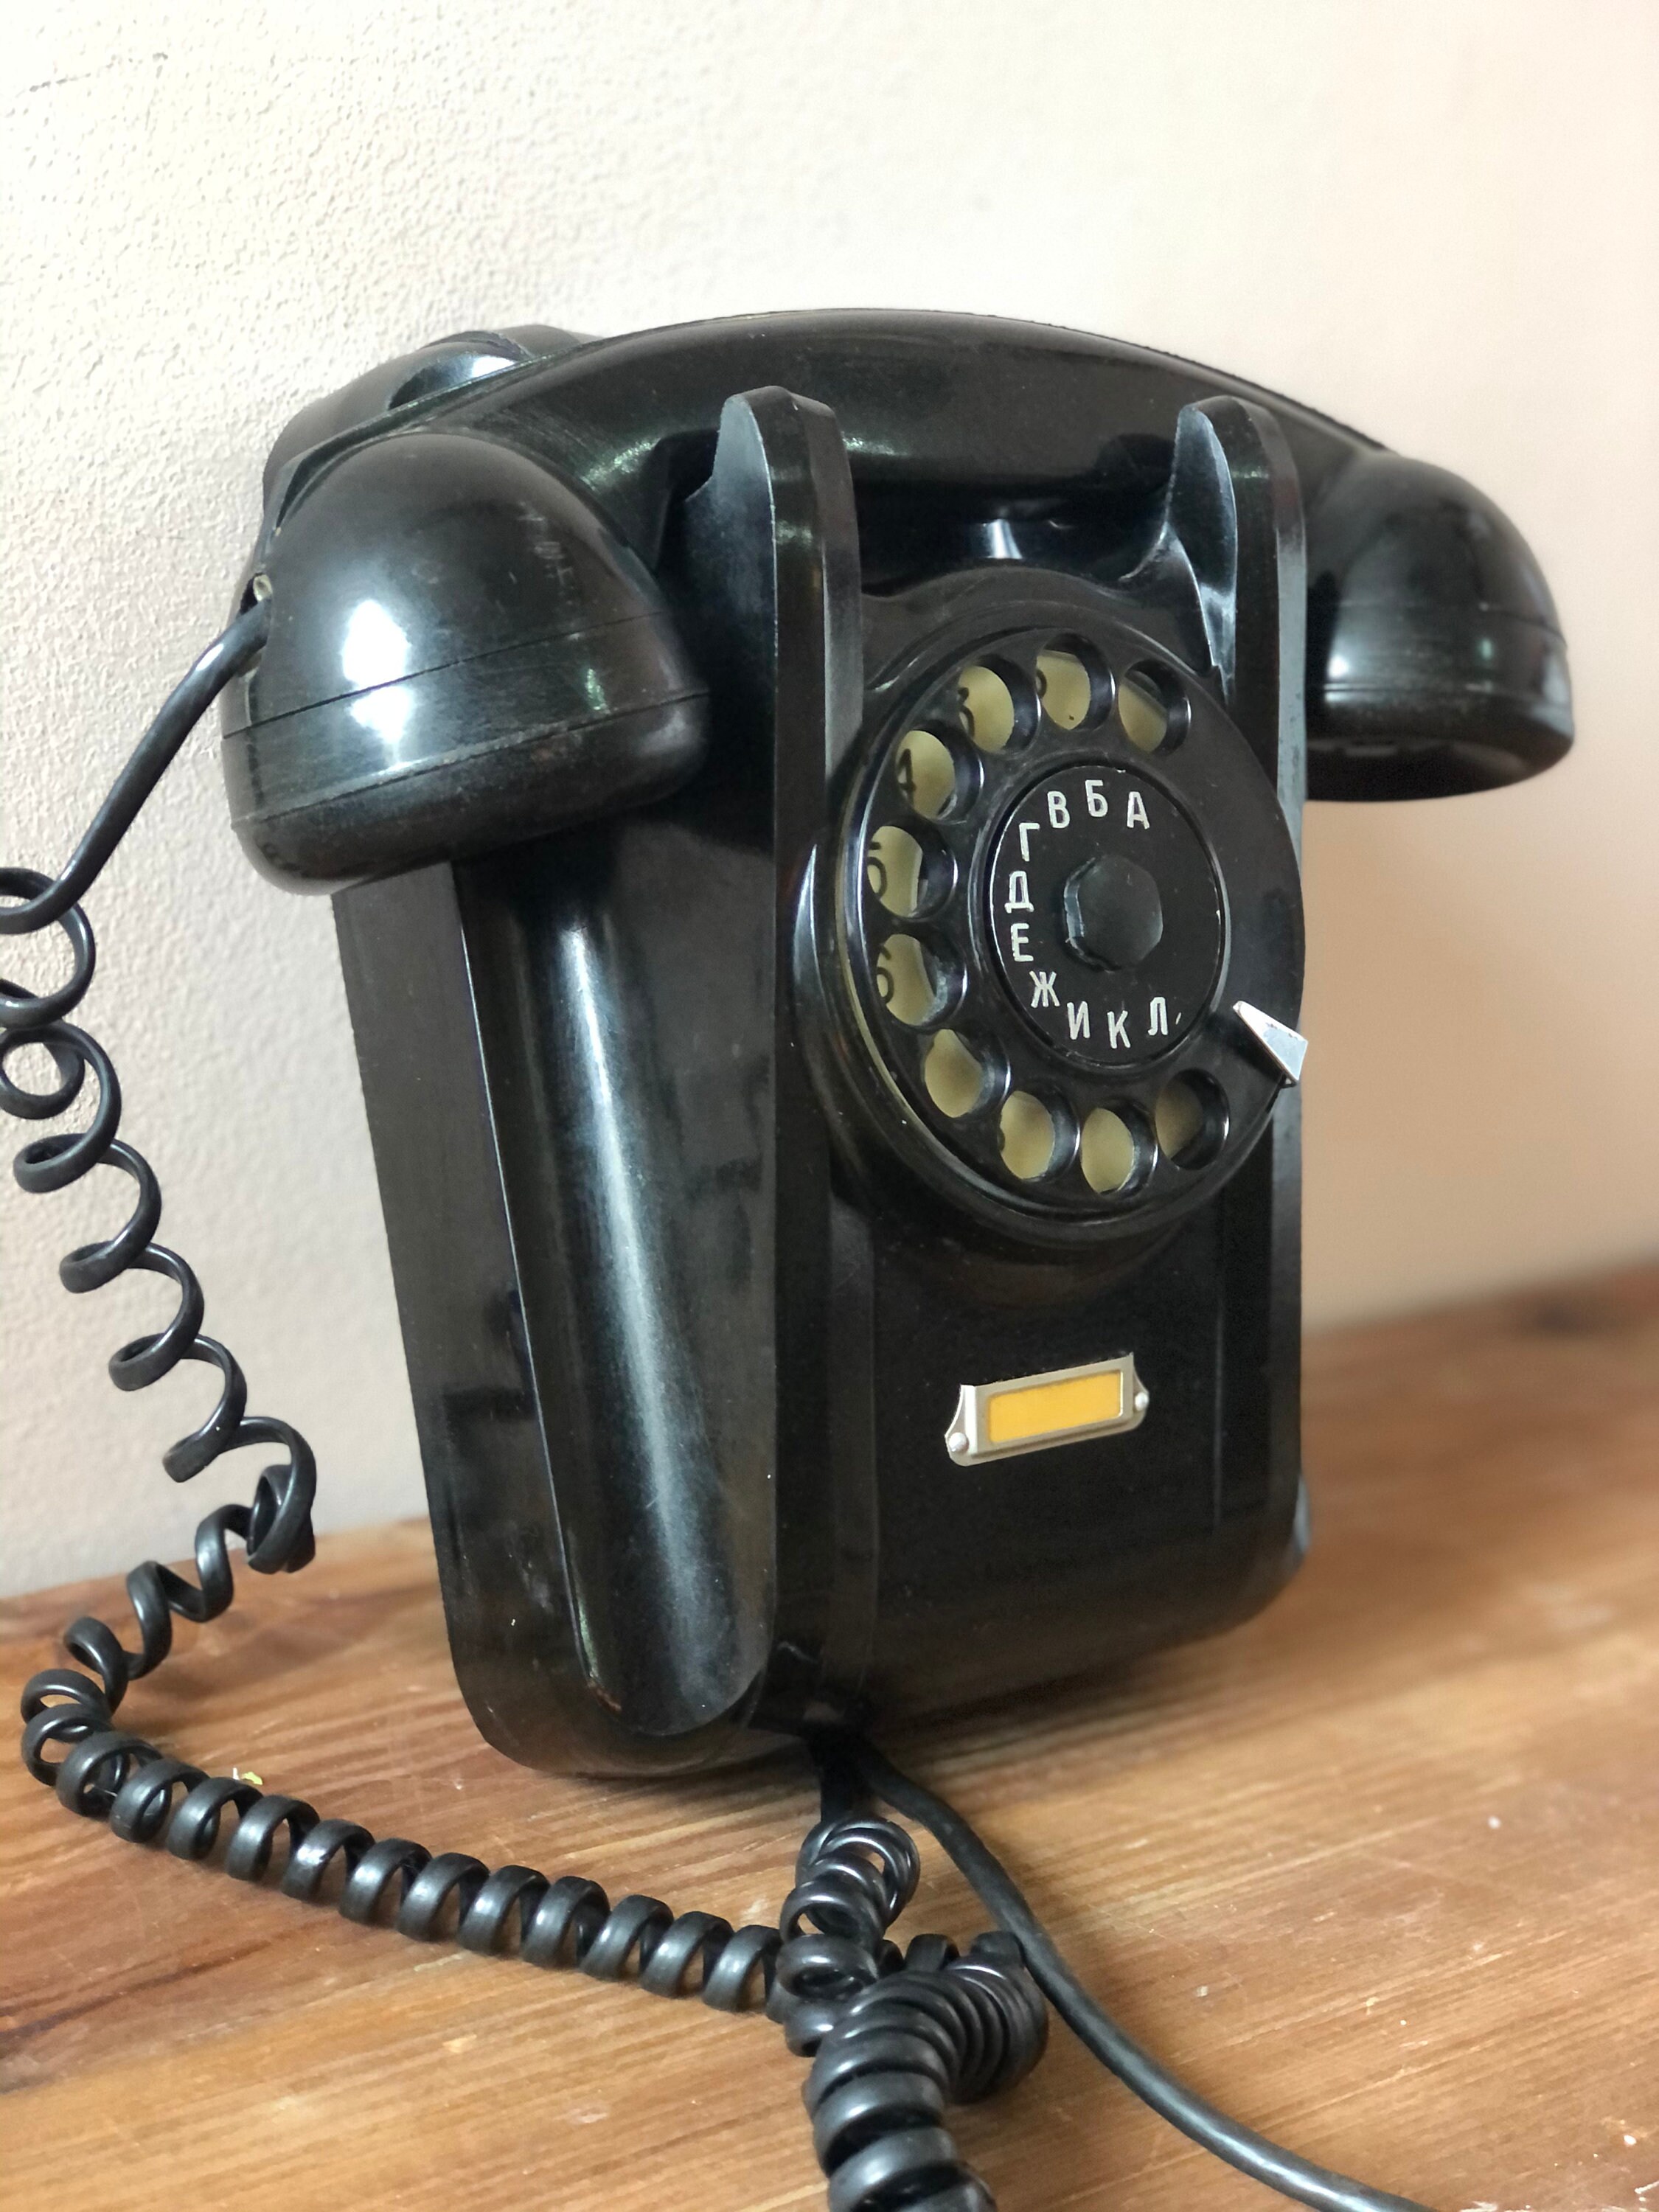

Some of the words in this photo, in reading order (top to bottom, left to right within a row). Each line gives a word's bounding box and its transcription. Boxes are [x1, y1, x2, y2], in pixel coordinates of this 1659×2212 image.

[896, 748, 917, 805] 4
[1046, 790, 1071, 829] В
[1085, 779, 1108, 818] Б
[1127, 790, 1150, 830] А
[1018, 822, 1040, 862] Г
[1004, 870, 1034, 914] Д
[1010, 922, 1034, 962] Е
[1029, 970, 1060, 1009] Ж
[1066, 1001, 1091, 1040] И
[1107, 1009, 1131, 1049] К
[1147, 996, 1169, 1036] Л
